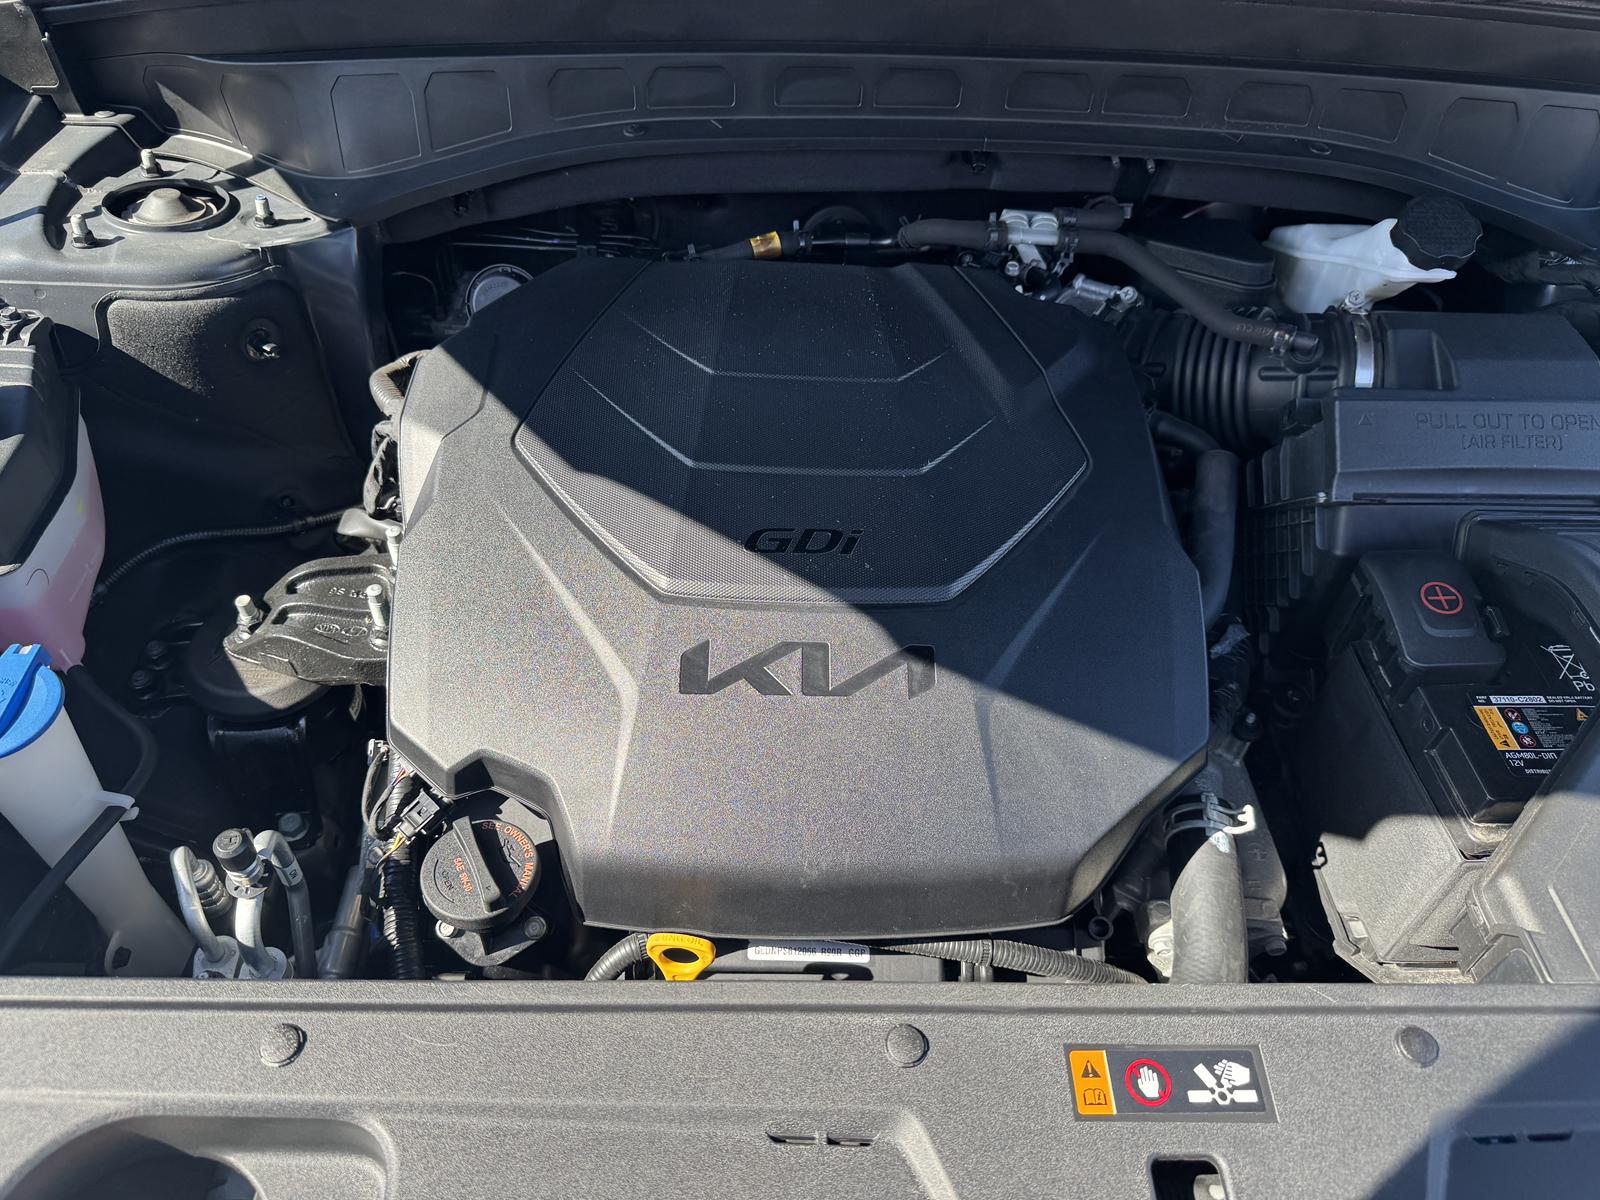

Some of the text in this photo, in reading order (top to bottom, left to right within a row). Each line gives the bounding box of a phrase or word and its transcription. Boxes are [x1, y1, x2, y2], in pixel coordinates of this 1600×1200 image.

[1415, 412, 1467, 429] PULL
[1473, 412, 1513, 430] OUT
[1519, 413, 1545, 430] TO
[1461, 434, 1563, 451] (AIR FILTER)
[744, 527, 864, 555] GDi
[679, 638, 937, 700] KIA
[1572, 680, 1596, 692] Pb
[481, 822, 535, 898] SEE OWNER'S MANUAL
[661, 934, 704, 947] ENG OIL
